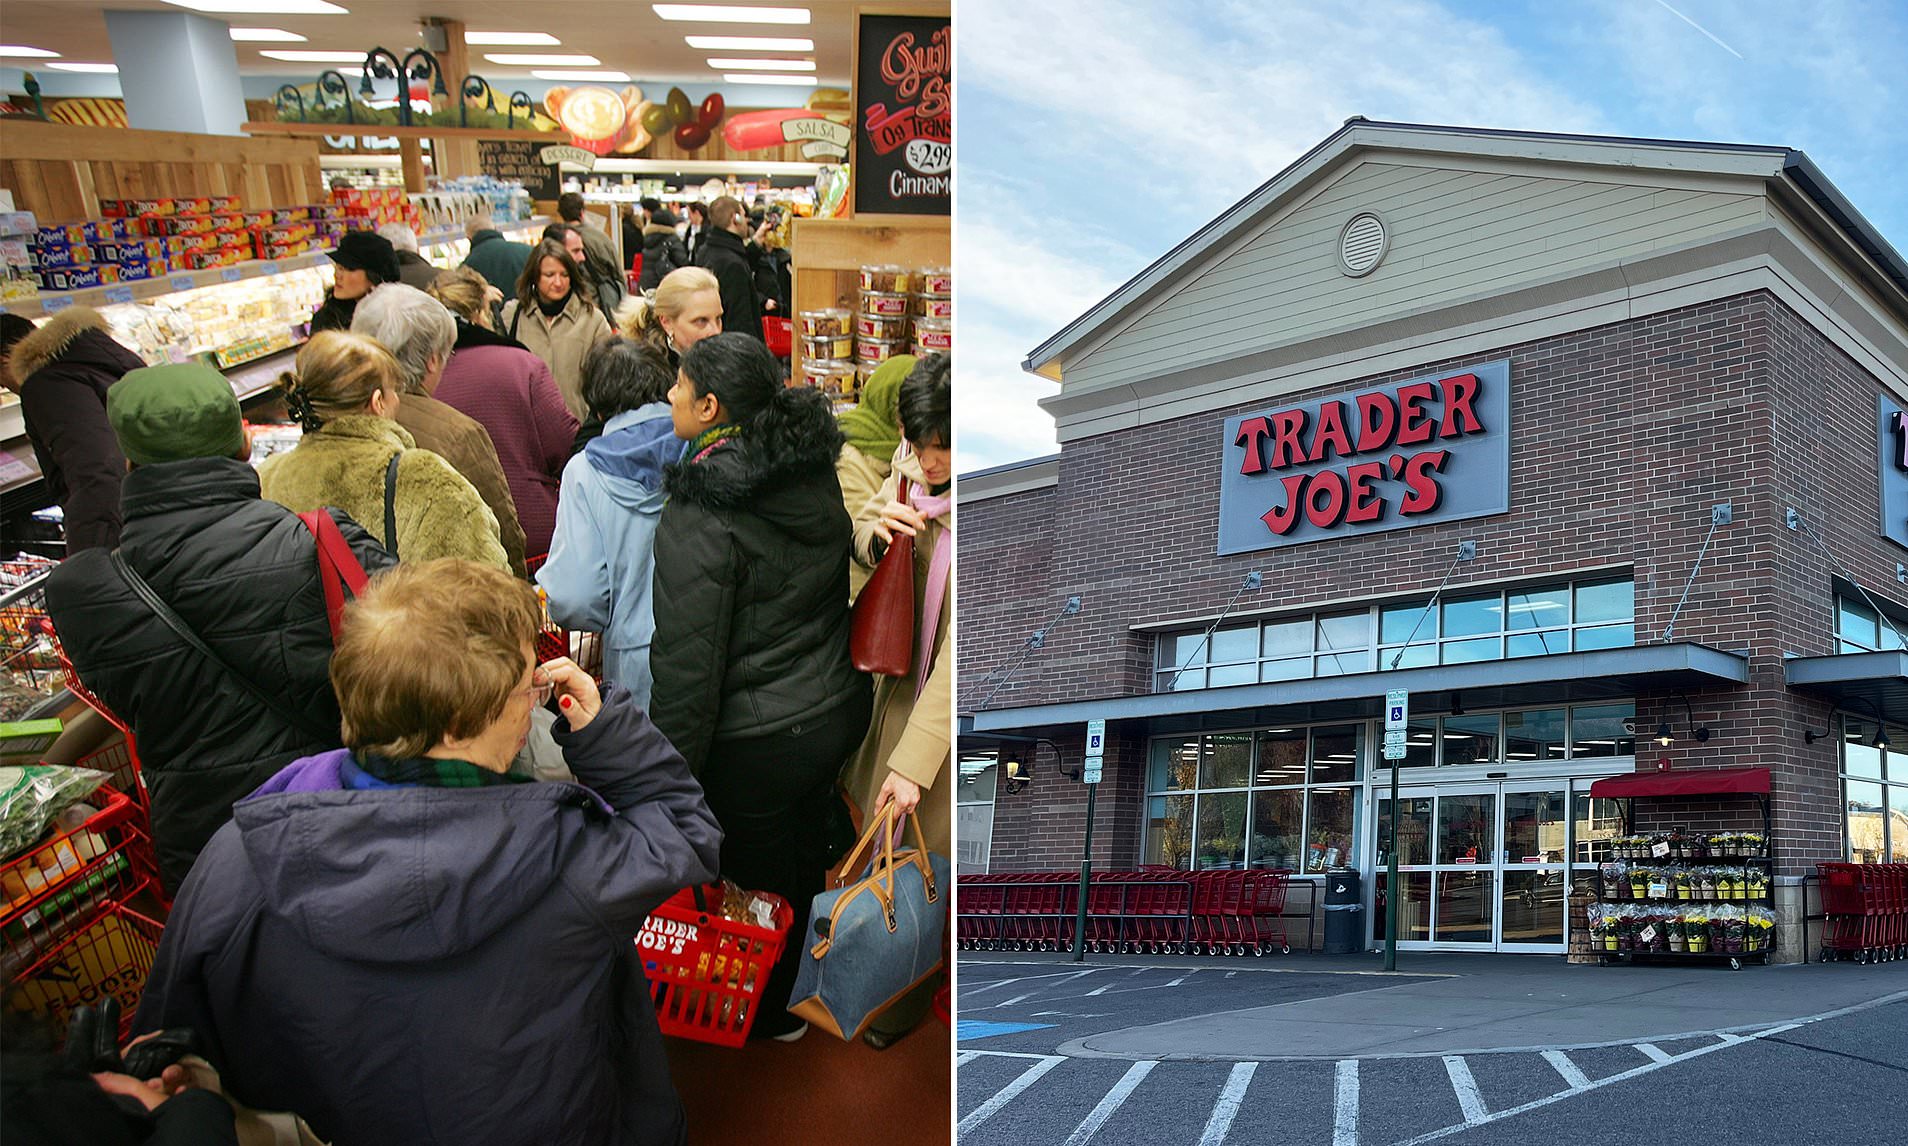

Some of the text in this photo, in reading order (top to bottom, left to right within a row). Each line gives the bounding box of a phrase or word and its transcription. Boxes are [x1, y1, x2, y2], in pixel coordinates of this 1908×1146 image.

[796, 121, 835, 139] SALSA
[546, 146, 588, 162] DESSERT
[890, 168, 951, 197] Cinnam
[1234, 373, 1487, 477] TRADER
[1260, 449, 1453, 536] JOE'S
[640, 915, 698, 942] RADER
